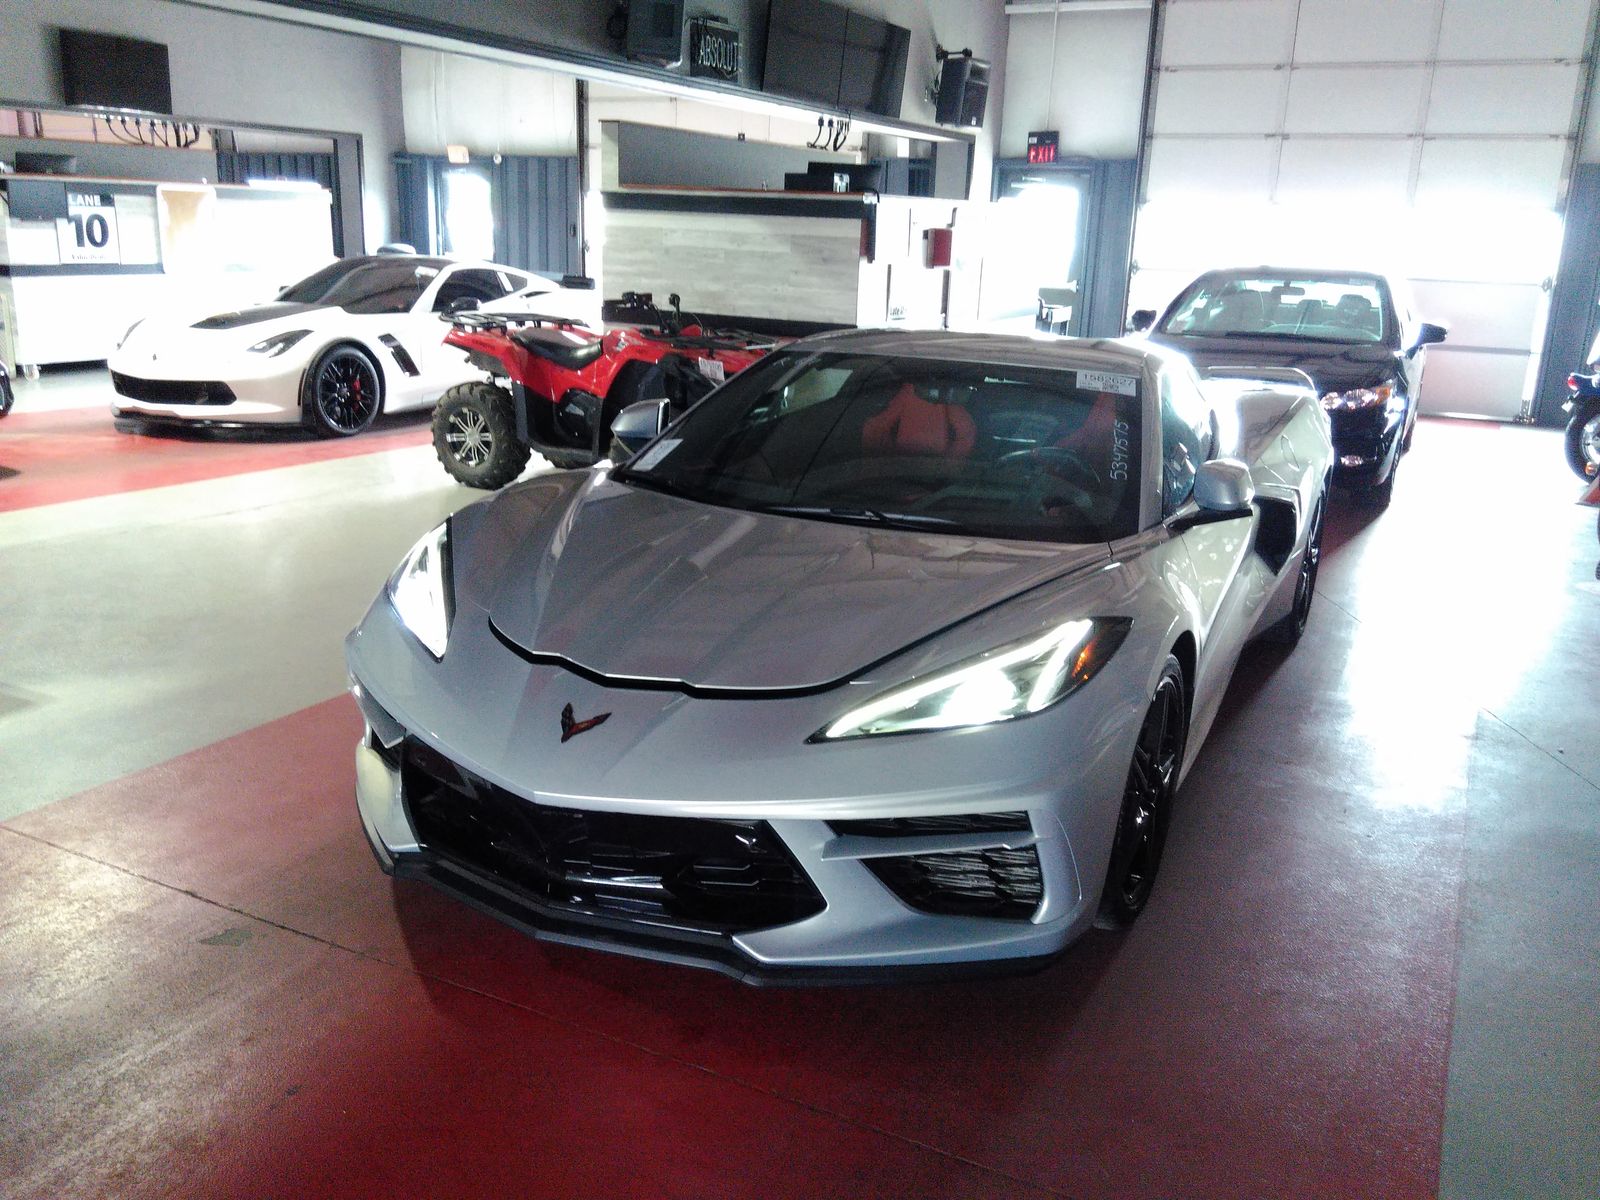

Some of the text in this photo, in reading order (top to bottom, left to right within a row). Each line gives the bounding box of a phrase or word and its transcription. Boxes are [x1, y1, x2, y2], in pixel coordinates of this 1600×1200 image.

[1029, 144, 1056, 164] EXIT
[68, 193, 102, 207] LANE
[67, 213, 109, 248] 10
[1110, 419, 1129, 480] 5347575
